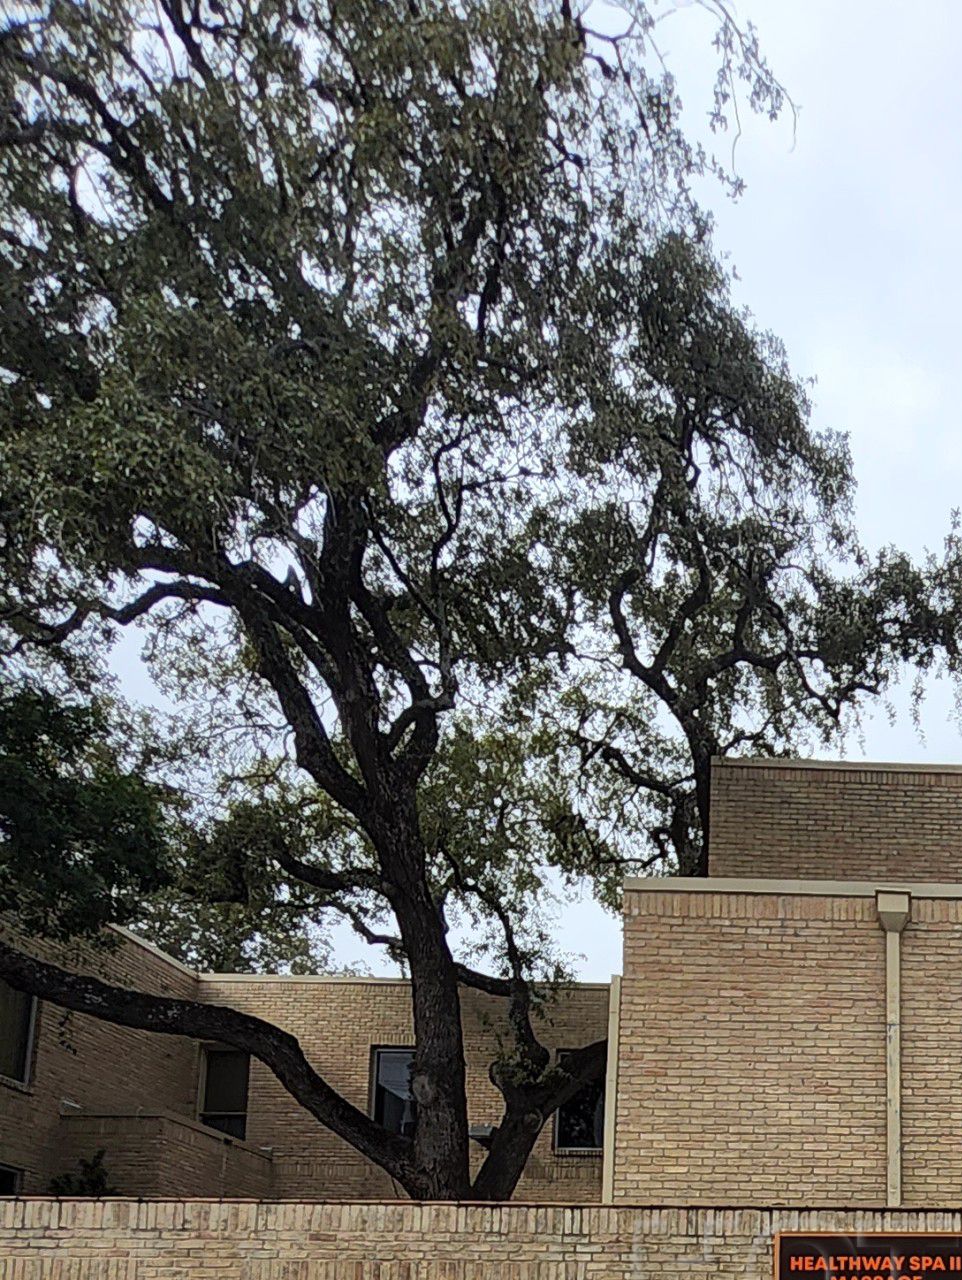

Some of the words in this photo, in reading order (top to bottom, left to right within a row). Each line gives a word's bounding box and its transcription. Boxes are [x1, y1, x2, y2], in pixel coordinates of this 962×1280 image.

[789, 1256, 905, 1271] HEALTHWAY
[909, 1256, 946, 1271] SPA
[950, 1256, 962, 1271] II
